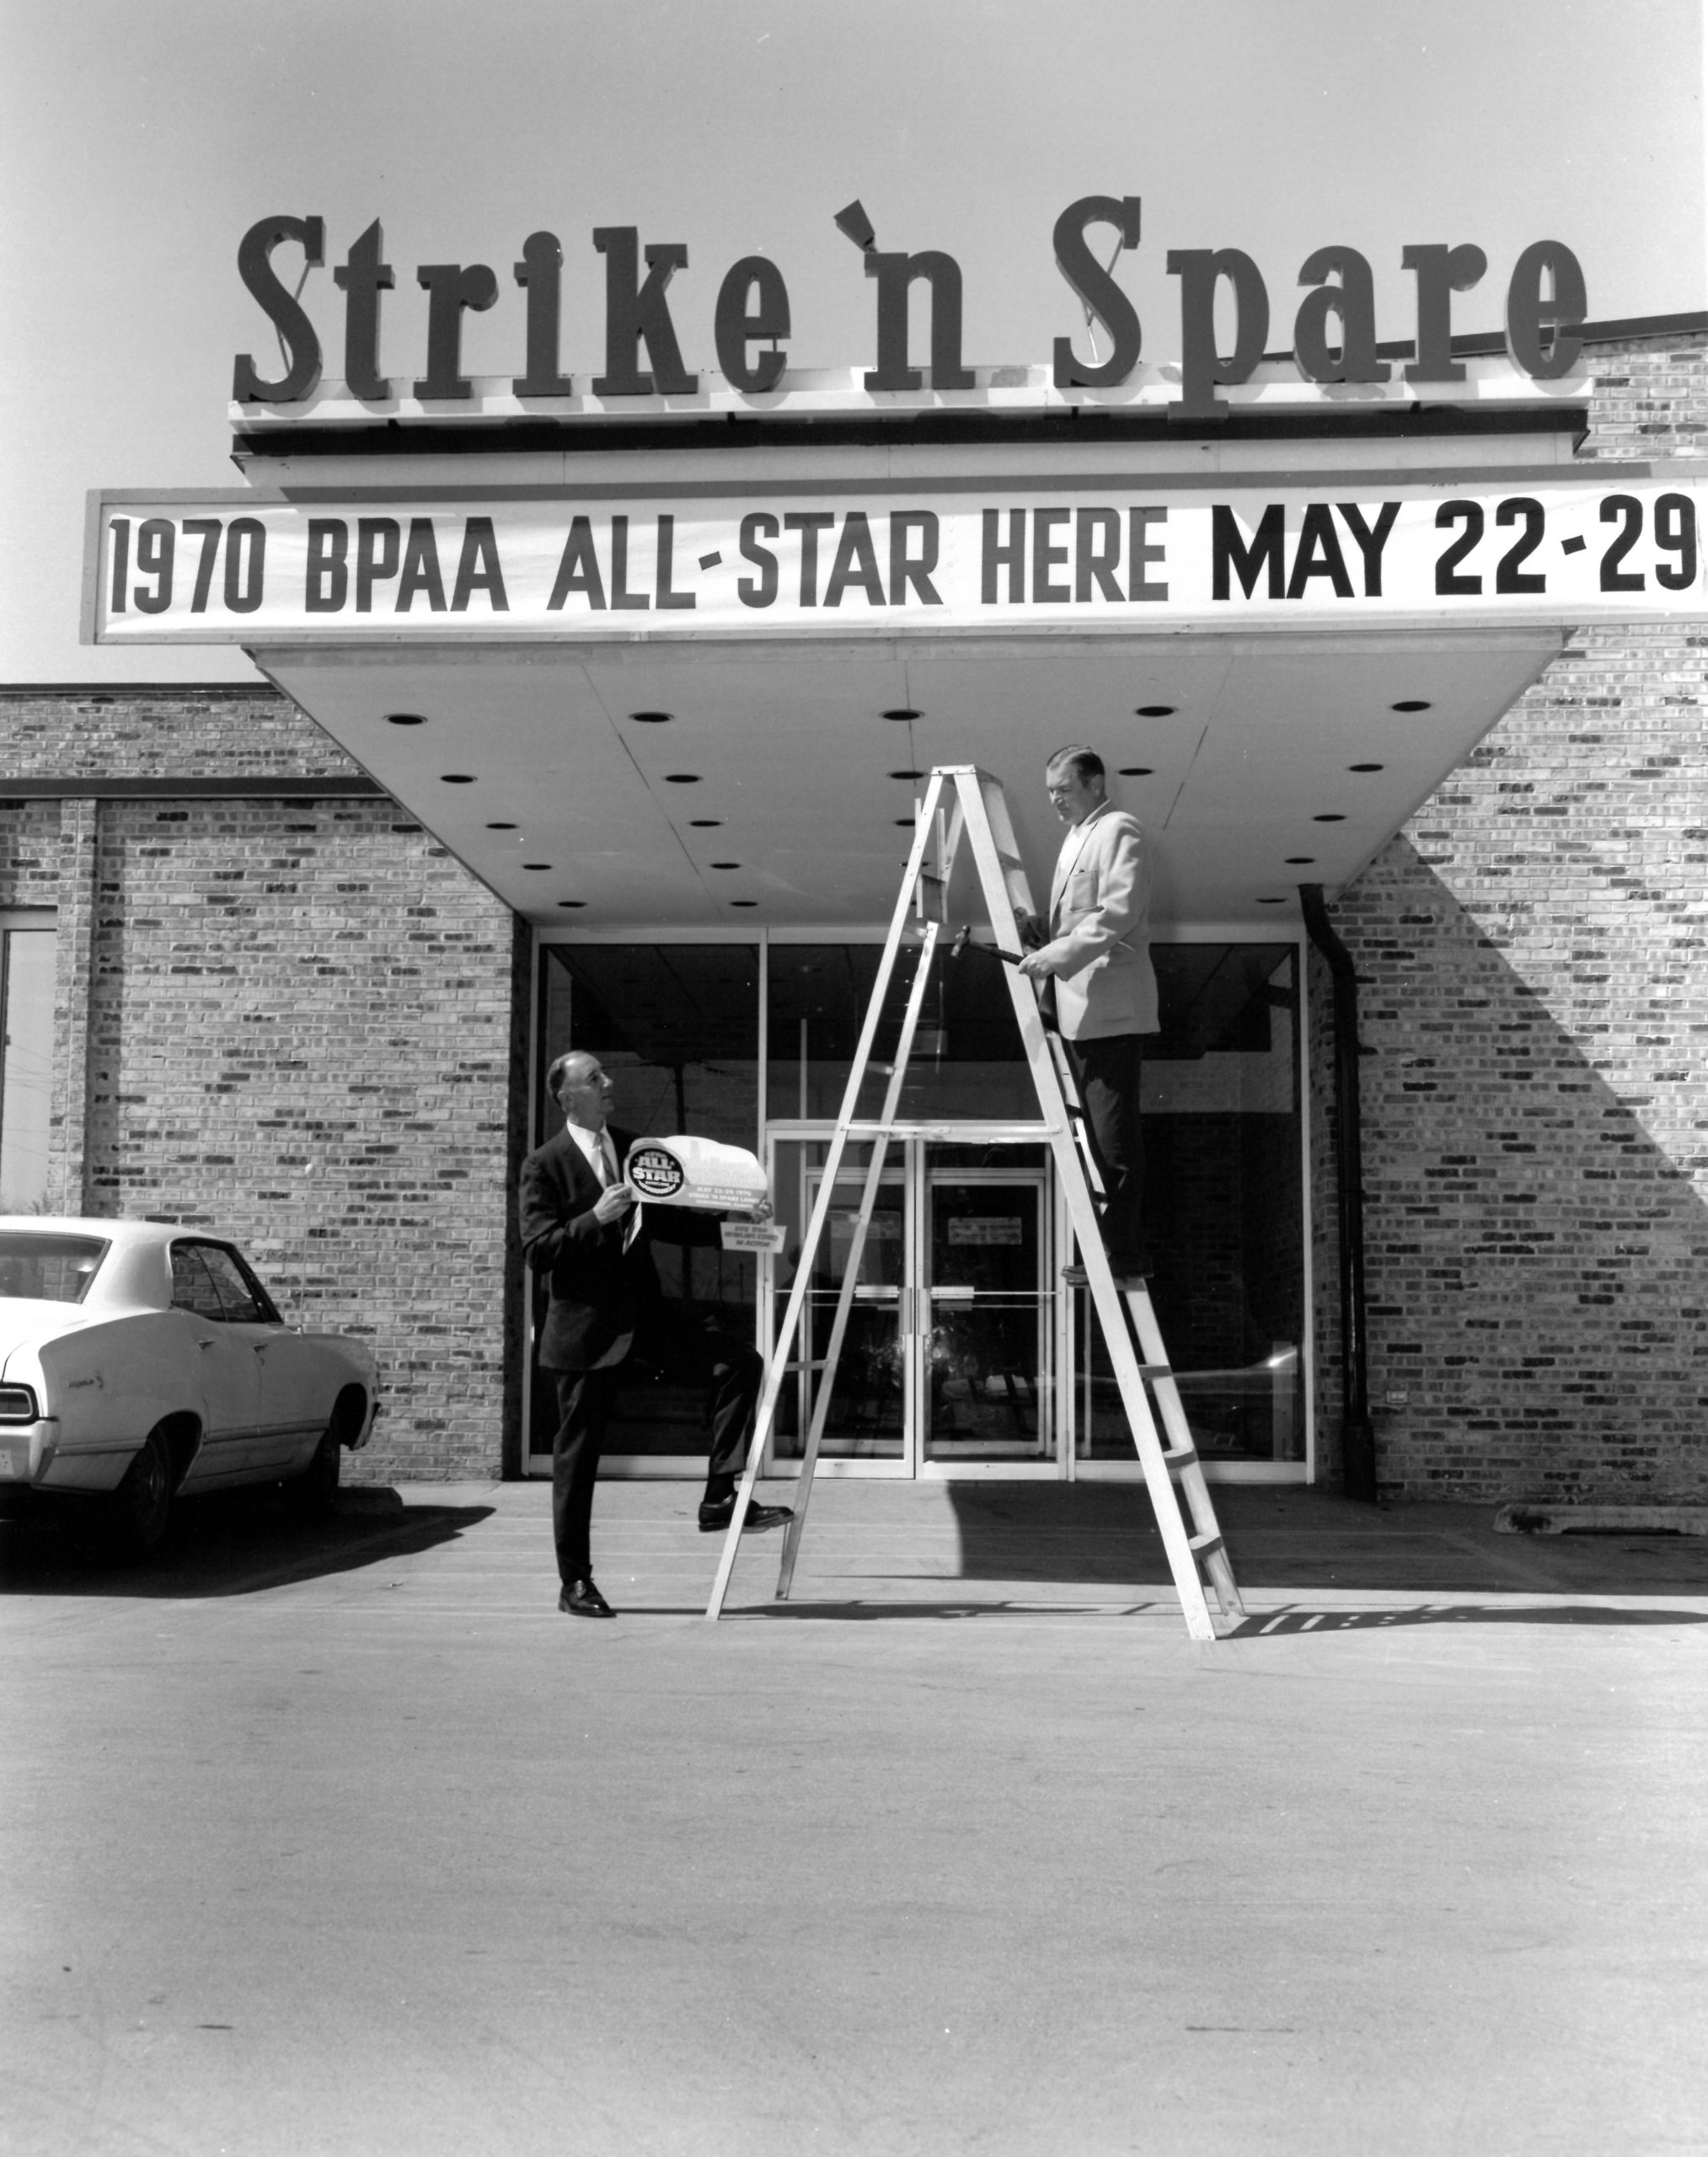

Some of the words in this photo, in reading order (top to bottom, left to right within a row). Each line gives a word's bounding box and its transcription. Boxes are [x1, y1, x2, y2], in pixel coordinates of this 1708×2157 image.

[233, 215, 792, 402] Strike
[1053, 195, 1588, 424] Spare
[109, 517, 267, 614] 1970
[304, 516, 511, 613] BPAA
[546, 509, 944, 611] ALL-STAR
[981, 506, 1170, 604] HERE
[1212, 501, 1402, 601] MAY
[1435, 492, 1697, 596] 22-29
[632, 1166, 681, 1183] STAR
[637, 1155, 672, 1170] ALL
